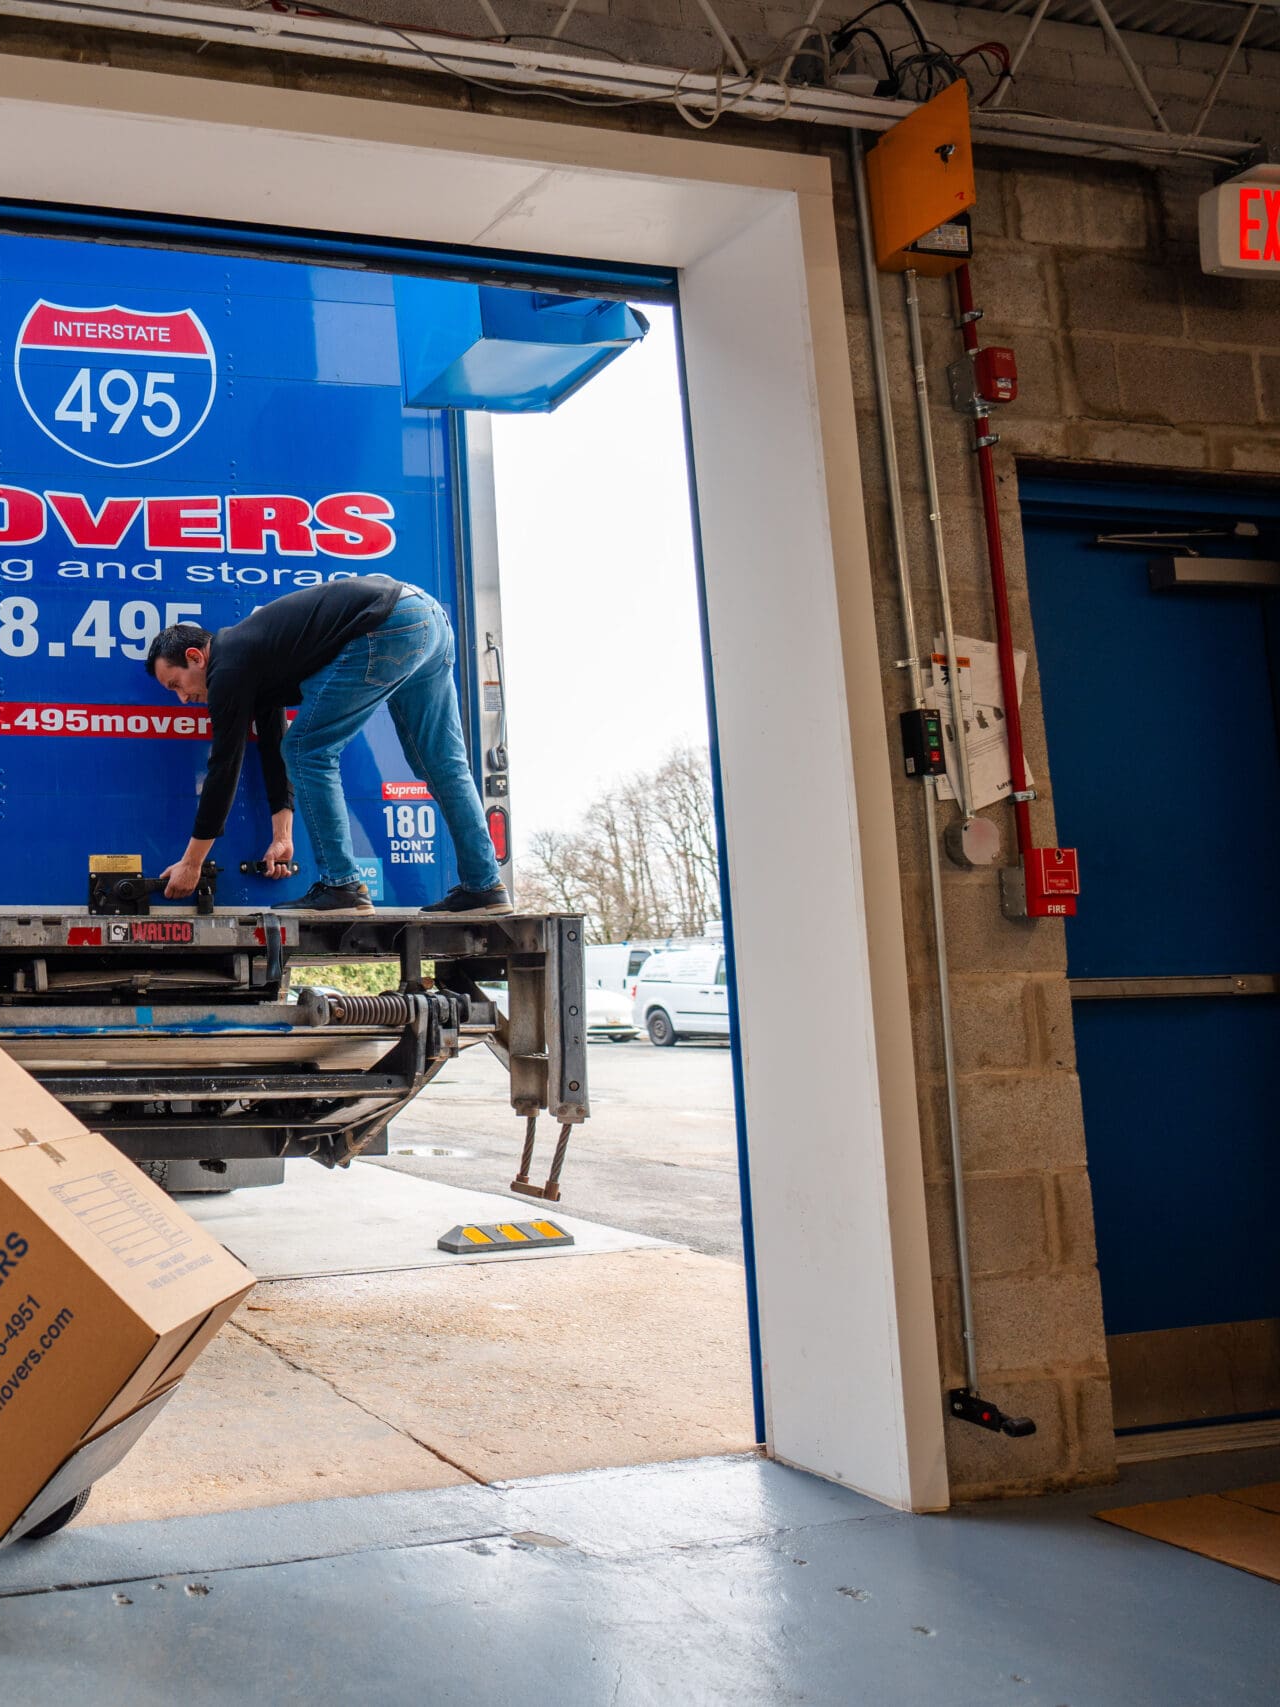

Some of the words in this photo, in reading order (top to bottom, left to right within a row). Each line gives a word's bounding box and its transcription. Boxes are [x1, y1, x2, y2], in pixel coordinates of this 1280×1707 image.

[53, 320, 171, 343] INTERSTATE
[54, 367, 181, 438] 495
[57, 558, 162, 582] and
[385, 783, 430, 798] Suprem
[383, 805, 436, 838] 180
[391, 840, 434, 851] DON'T
[391, 852, 436, 864] BLINK
[1047, 904, 1067, 914] FIRE
[131, 922, 192, 942] WALTCO
